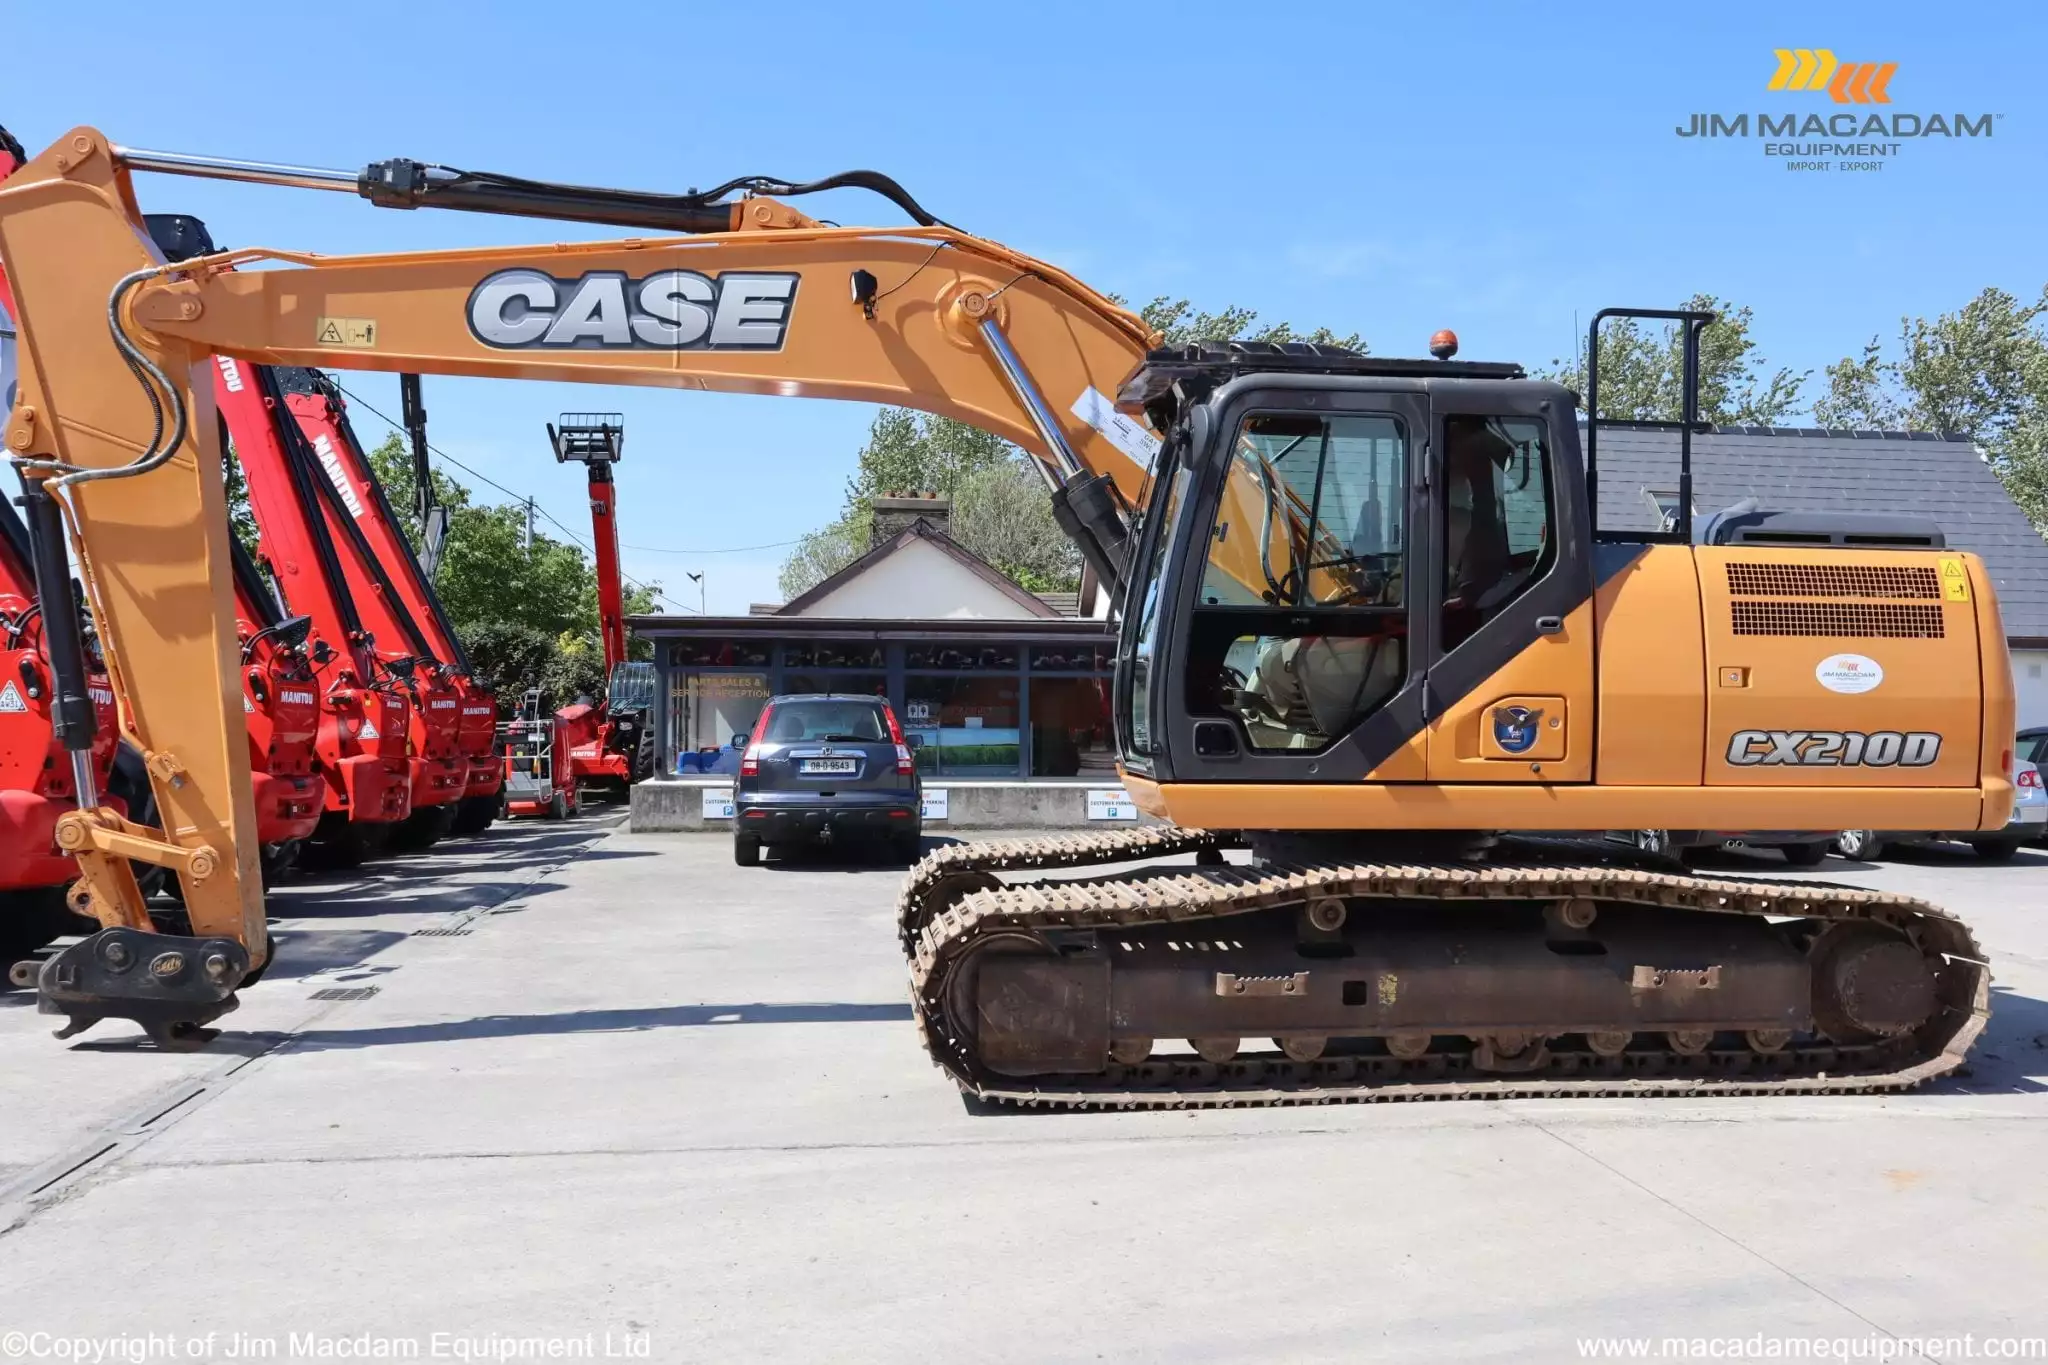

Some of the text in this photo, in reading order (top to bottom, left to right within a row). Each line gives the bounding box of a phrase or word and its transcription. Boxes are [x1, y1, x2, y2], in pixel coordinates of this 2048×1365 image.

[468, 270, 799, 349] CASE
[216, 354, 244, 392] ITOU
[313, 433, 364, 518] MANITOU
[720, 678, 751, 687] SALES
[88, 688, 112, 705] ITOU
[281, 691, 314, 705] MANITOU
[671, 689, 770, 698] SERVICE RECEPTION
[431, 700, 456, 709] MANITOU
[1726, 730, 1943, 767] CX210D
[810, 761, 850, 770] 08-D-9543
